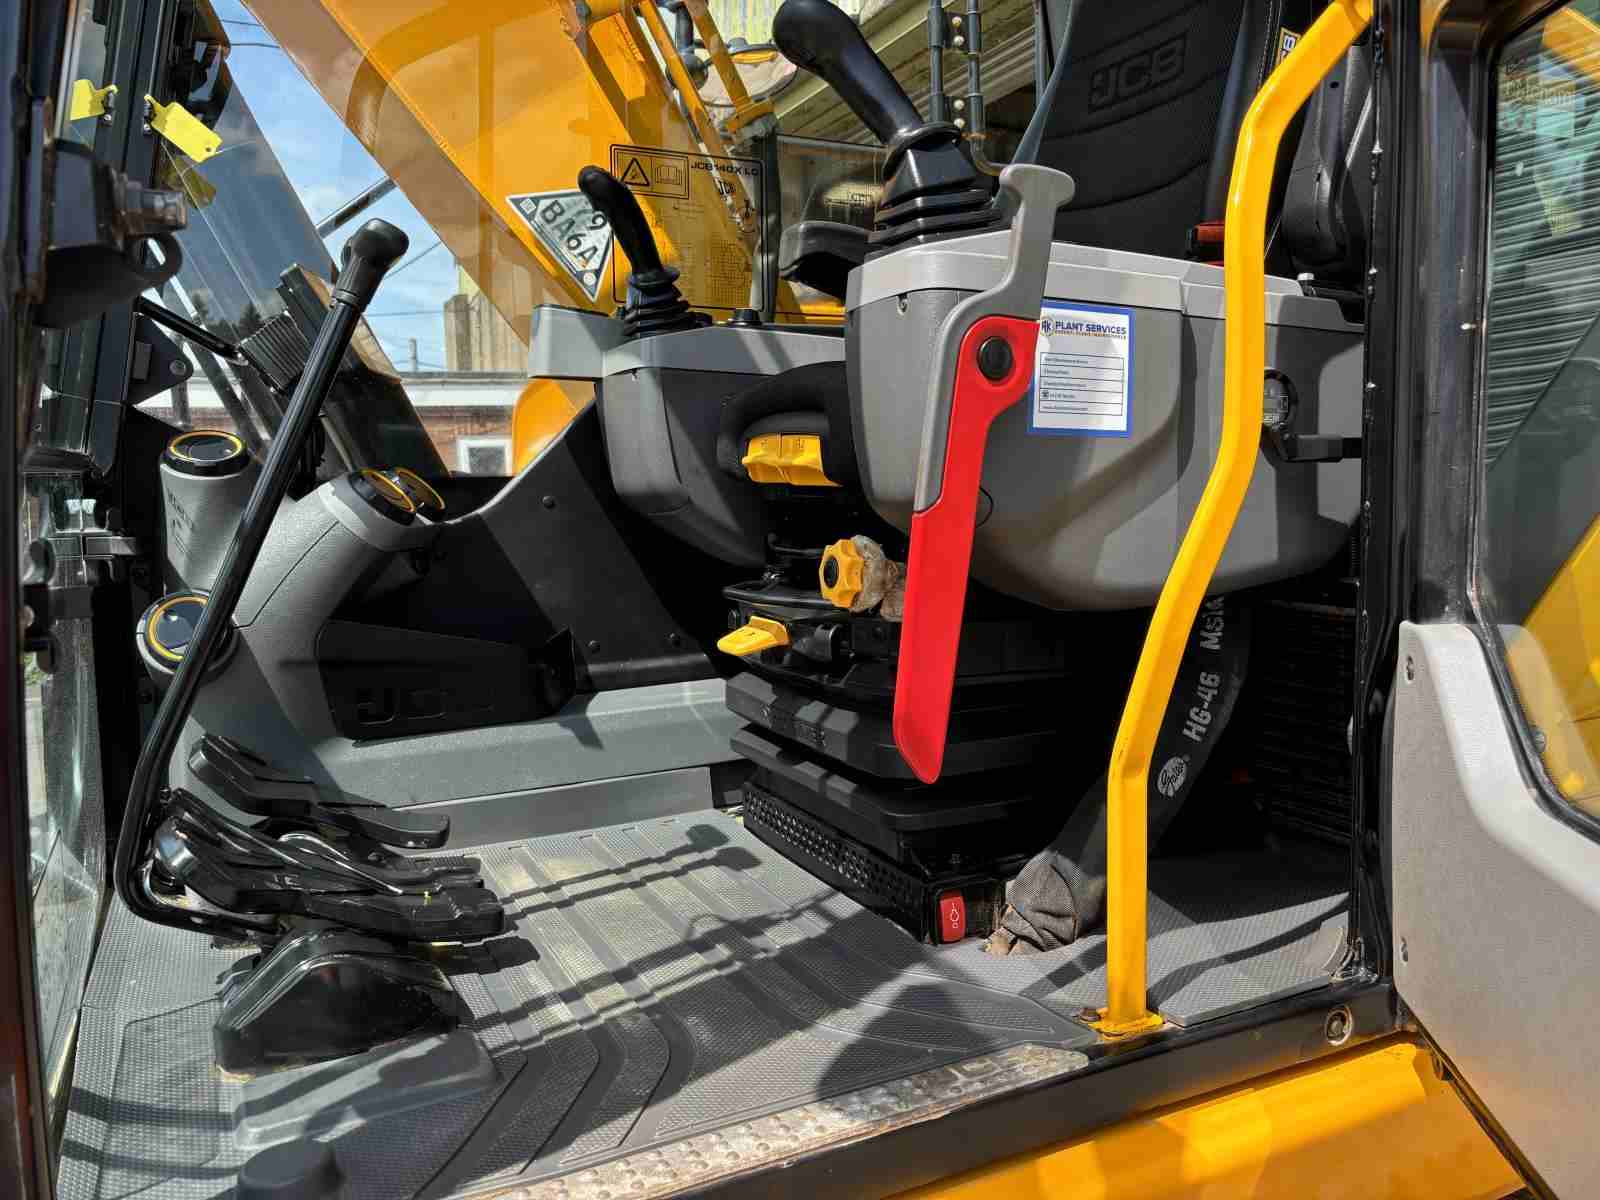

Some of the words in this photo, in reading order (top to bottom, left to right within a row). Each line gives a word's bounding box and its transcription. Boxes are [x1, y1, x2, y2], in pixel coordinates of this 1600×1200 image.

[1089, 37, 1185, 107] JCB
[1055, 320, 1084, 332] PLANT
[1086, 323, 1127, 335] SERVICES
[1182, 671, 1222, 743] HG-46
